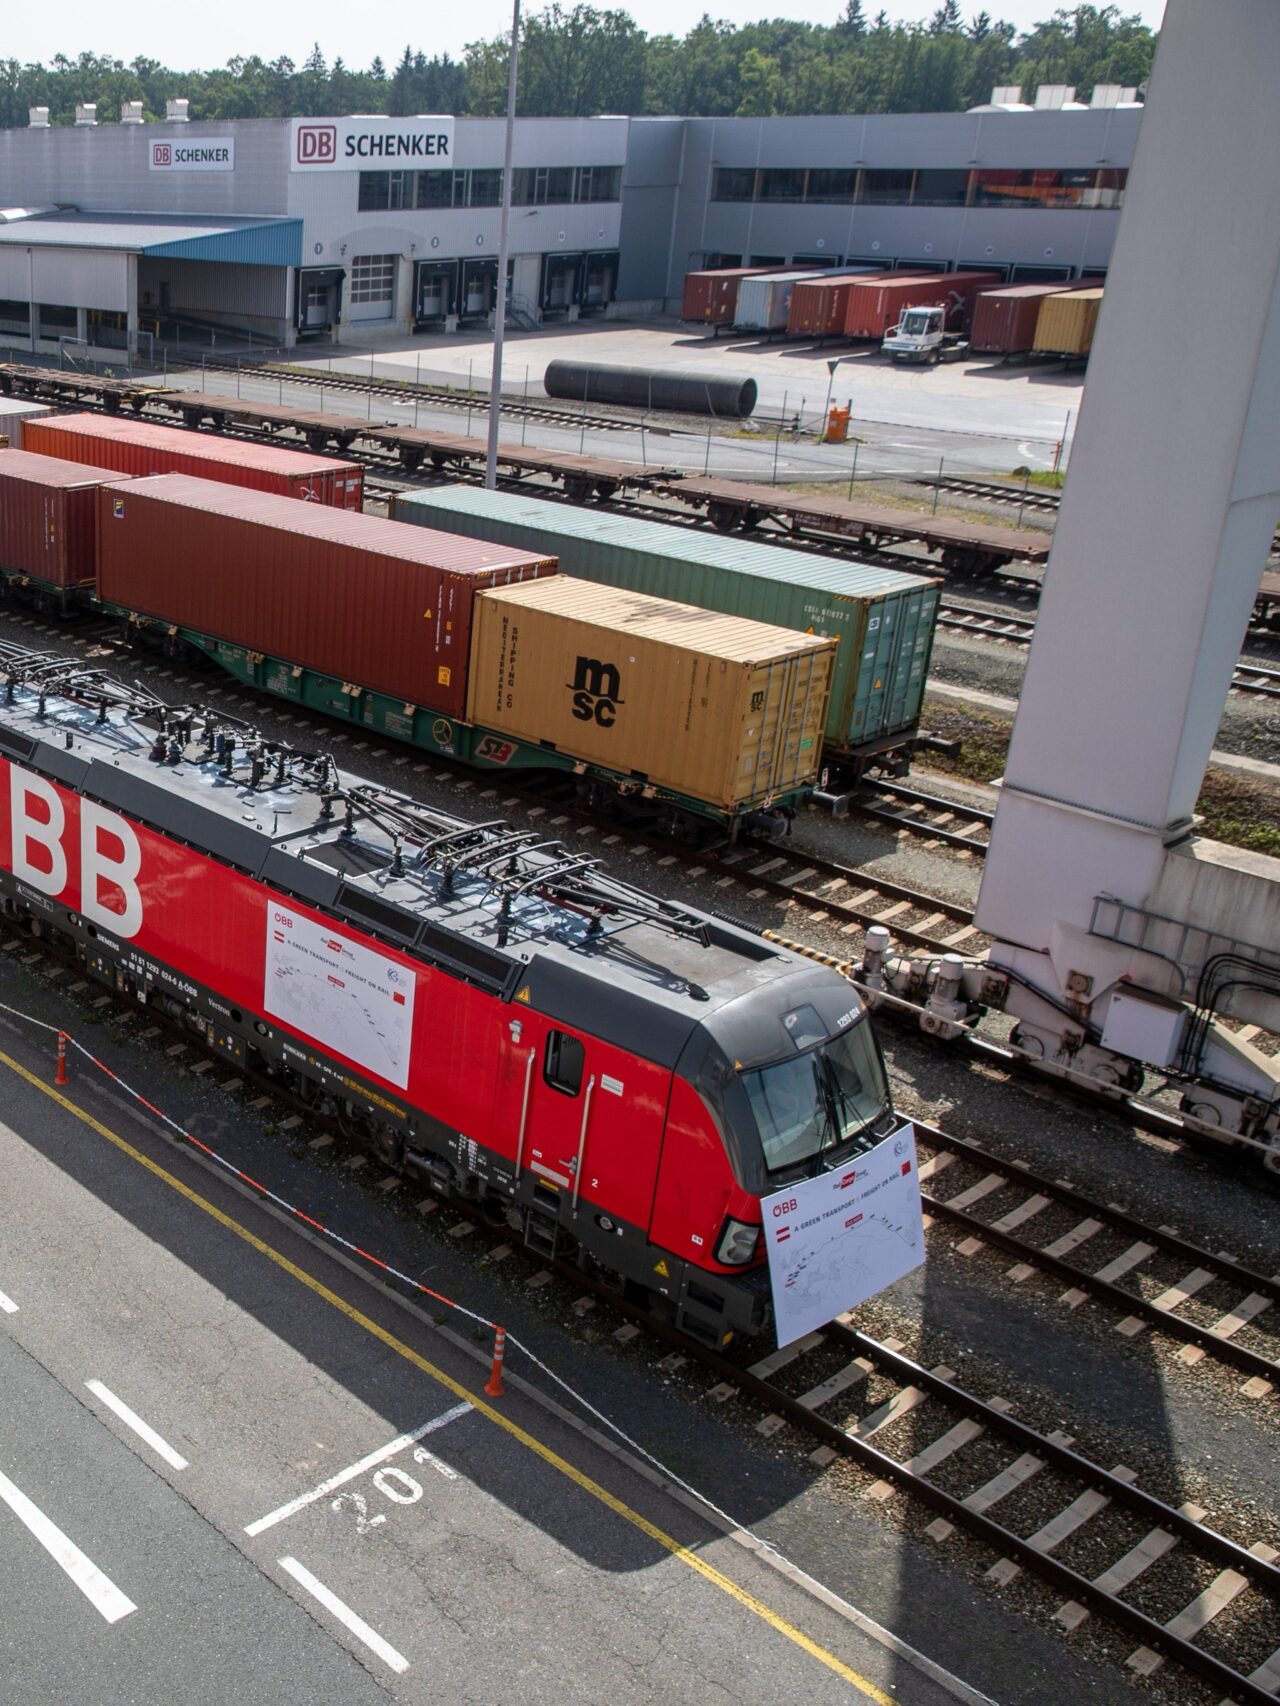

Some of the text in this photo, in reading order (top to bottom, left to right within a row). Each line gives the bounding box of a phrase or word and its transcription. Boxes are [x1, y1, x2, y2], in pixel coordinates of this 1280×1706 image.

[299, 128, 450, 161] DB SCHENKER
[174, 147, 229, 164] SCHENKER
[274, 912, 293, 929] ÖBB
[96, 933, 120, 952] SIEMENS
[146, 961, 160, 975] 1293
[292, 942, 309, 954] GREEN
[309, 951, 339, 970] TRANSPORT
[345, 970, 368, 984] FREIGHT
[208, 997, 231, 1017] Vectron
[591, 1178, 599, 1188] 2
[773, 1198, 798, 1218] ÖBB
[800, 1217, 821, 1229] GREEN
[822, 1198, 856, 1220] TRANSPORT
